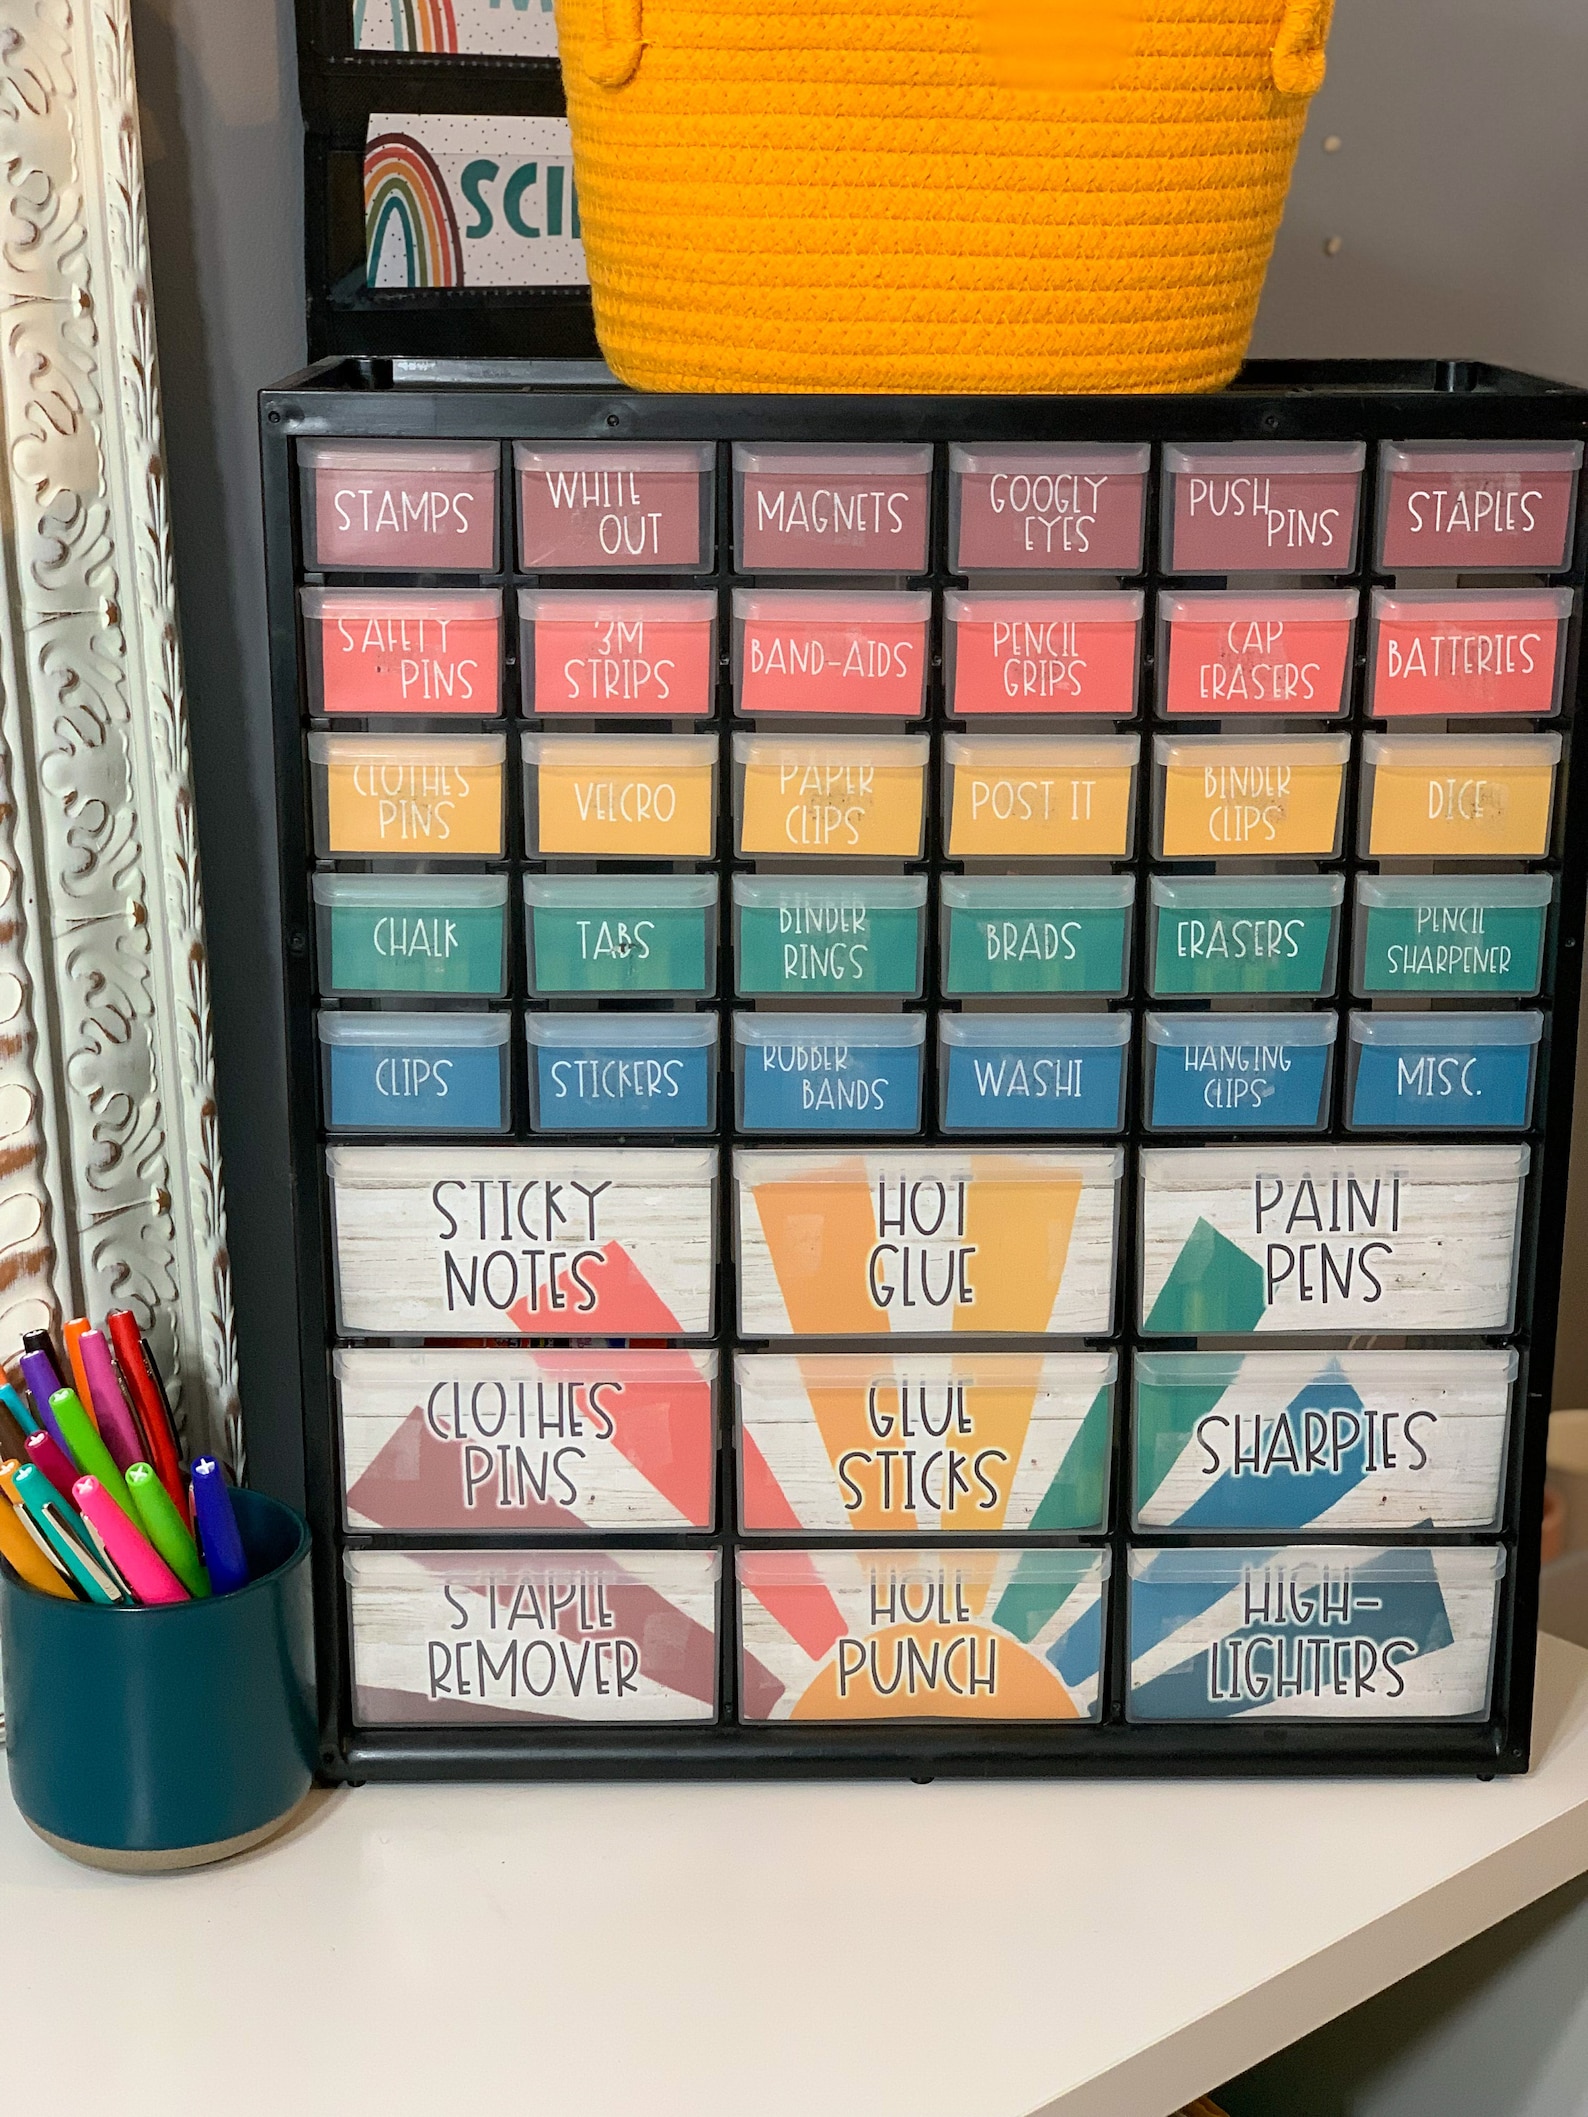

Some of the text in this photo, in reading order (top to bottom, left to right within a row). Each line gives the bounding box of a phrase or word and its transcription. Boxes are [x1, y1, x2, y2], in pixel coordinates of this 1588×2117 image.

[545, 470, 641, 509] WHITE
[990, 473, 1108, 514] GOOGLY
[1190, 478, 1269, 517] PUSH
[335, 491, 473, 532] STAMPS
[757, 490, 909, 533] MAGNETS
[1266, 508, 1340, 548] PINS
[1407, 491, 1543, 532] STAPLES
[600, 513, 662, 555] OUT
[1024, 516, 1096, 553] EYES
[338, 617, 452, 653] SAFETY
[594, 615, 645, 655] 3M
[993, 620, 1079, 659] PENCIL
[1228, 620, 1285, 652] CAP
[751, 639, 914, 678] BAND-AIDS
[1388, 633, 1542, 678] BATTERIES
[401, 659, 478, 699] PINS
[564, 659, 675, 699] STRIPS
[1003, 658, 1088, 698] GRIPS
[1199, 663, 1321, 701] ERASERS
[353, 763, 470, 797] CLOTHES
[780, 759, 875, 796] PAPER
[1204, 766, 1292, 799] BINDER
[573, 782, 677, 822] VELCRO
[971, 780, 1097, 821] POST IT
[1429, 778, 1488, 820] DICE
[379, 801, 456, 840] PINS
[785, 804, 866, 845] CLIPS
[1208, 805, 1283, 842] CLIPS
[779, 898, 867, 934] BINDER
[1416, 906, 1486, 936] PENCIL
[373, 916, 459, 959] CHALK
[576, 920, 656, 960] TABS
[986, 921, 1084, 961] BRADS
[1177, 918, 1306, 959] ERASERS
[784, 942, 869, 980] RINGS
[1387, 945, 1512, 975] SHARPENER
[763, 1041, 849, 1072] RUBBER
[1184, 1045, 1292, 1072] HANGING
[375, 1059, 453, 1097] CLIPS
[551, 1059, 684, 1099] STICKERS
[802, 1077, 889, 1111] BANDS
[973, 1059, 1083, 1098] WASHI
[1203, 1078, 1268, 1109] CLIPS
[1396, 1057, 1482, 1097] MISC.
[432, 1179, 613, 1242] STICKY
[878, 1173, 974, 1237] HOT
[1254, 1171, 1409, 1235] PAINT
[444, 1249, 607, 1312] NOTES
[868, 1244, 977, 1308] GLUE
[1265, 1242, 1394, 1306] PENS
[425, 1380, 624, 1440] CLOTHES
[868, 1376, 974, 1438] GLUE
[1196, 1409, 1439, 1476] SHARPIES
[463, 1444, 587, 1507] PINS
[838, 1448, 1008, 1510] STICKS
[443, 1575, 613, 1631] STAPLE
[870, 1567, 970, 1625] HOLE
[1242, 1564, 1380, 1625] HIGH-
[428, 1639, 639, 1698] REMOVER
[839, 1636, 996, 1697] PUNCH
[1208, 1639, 1417, 1699] LIGHTERS
